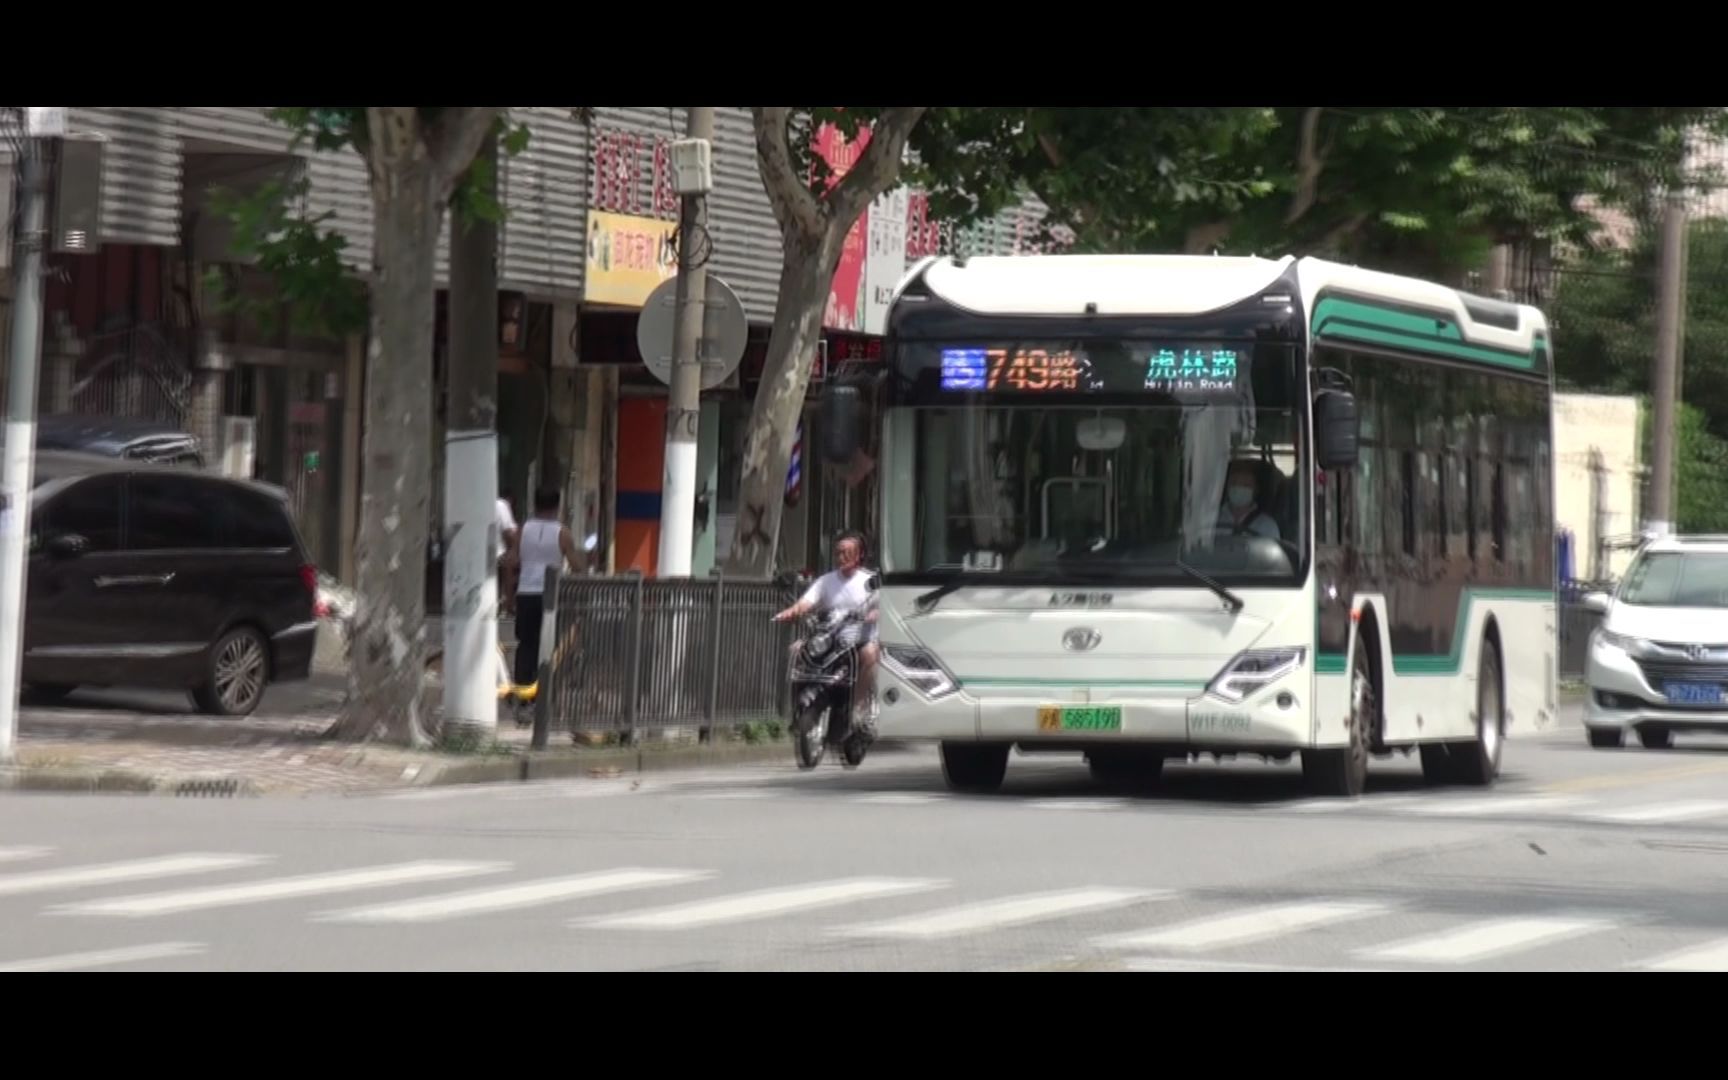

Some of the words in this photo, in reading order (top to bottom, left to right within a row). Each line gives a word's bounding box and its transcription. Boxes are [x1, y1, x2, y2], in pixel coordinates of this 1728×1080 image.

[1147, 349, 1237, 378] 虎林路
[1200, 380, 1233, 389] Road
